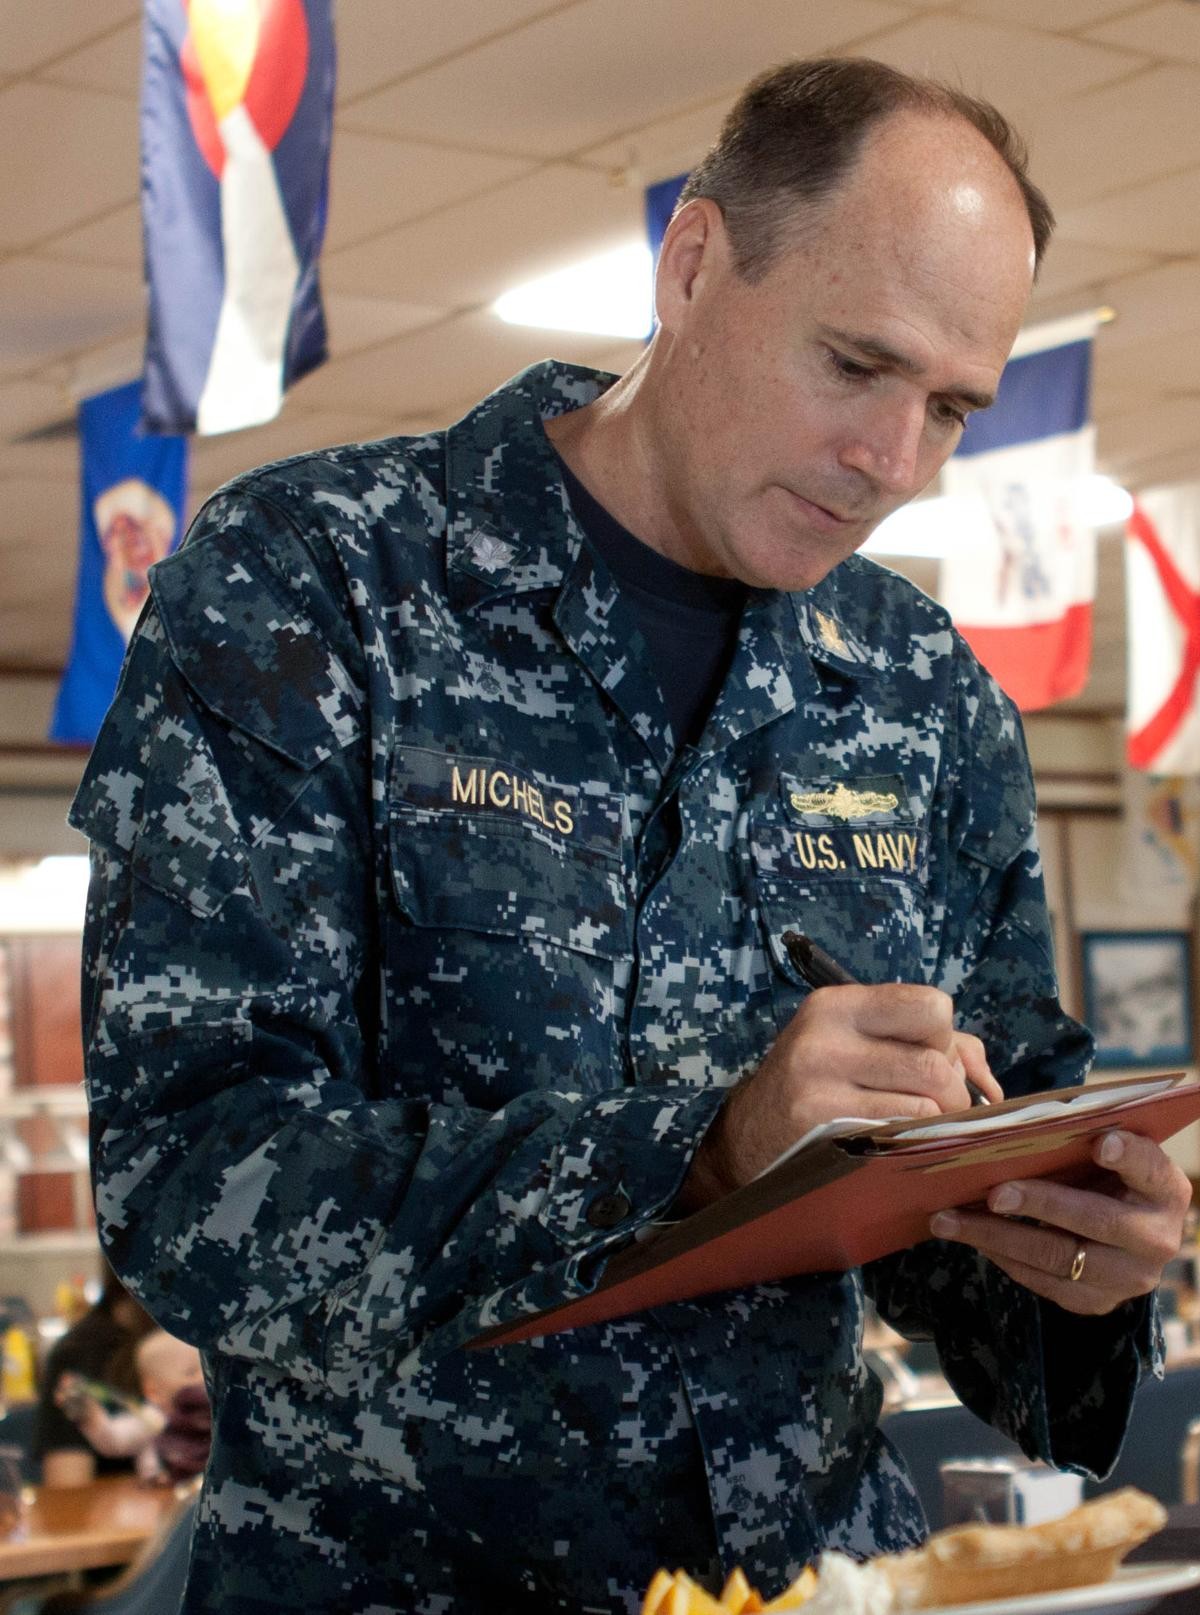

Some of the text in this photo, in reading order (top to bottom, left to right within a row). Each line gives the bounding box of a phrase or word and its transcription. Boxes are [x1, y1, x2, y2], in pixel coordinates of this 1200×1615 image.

[452, 766, 574, 834] MICHELS
[795, 832, 918, 873] U.S. NAVY
